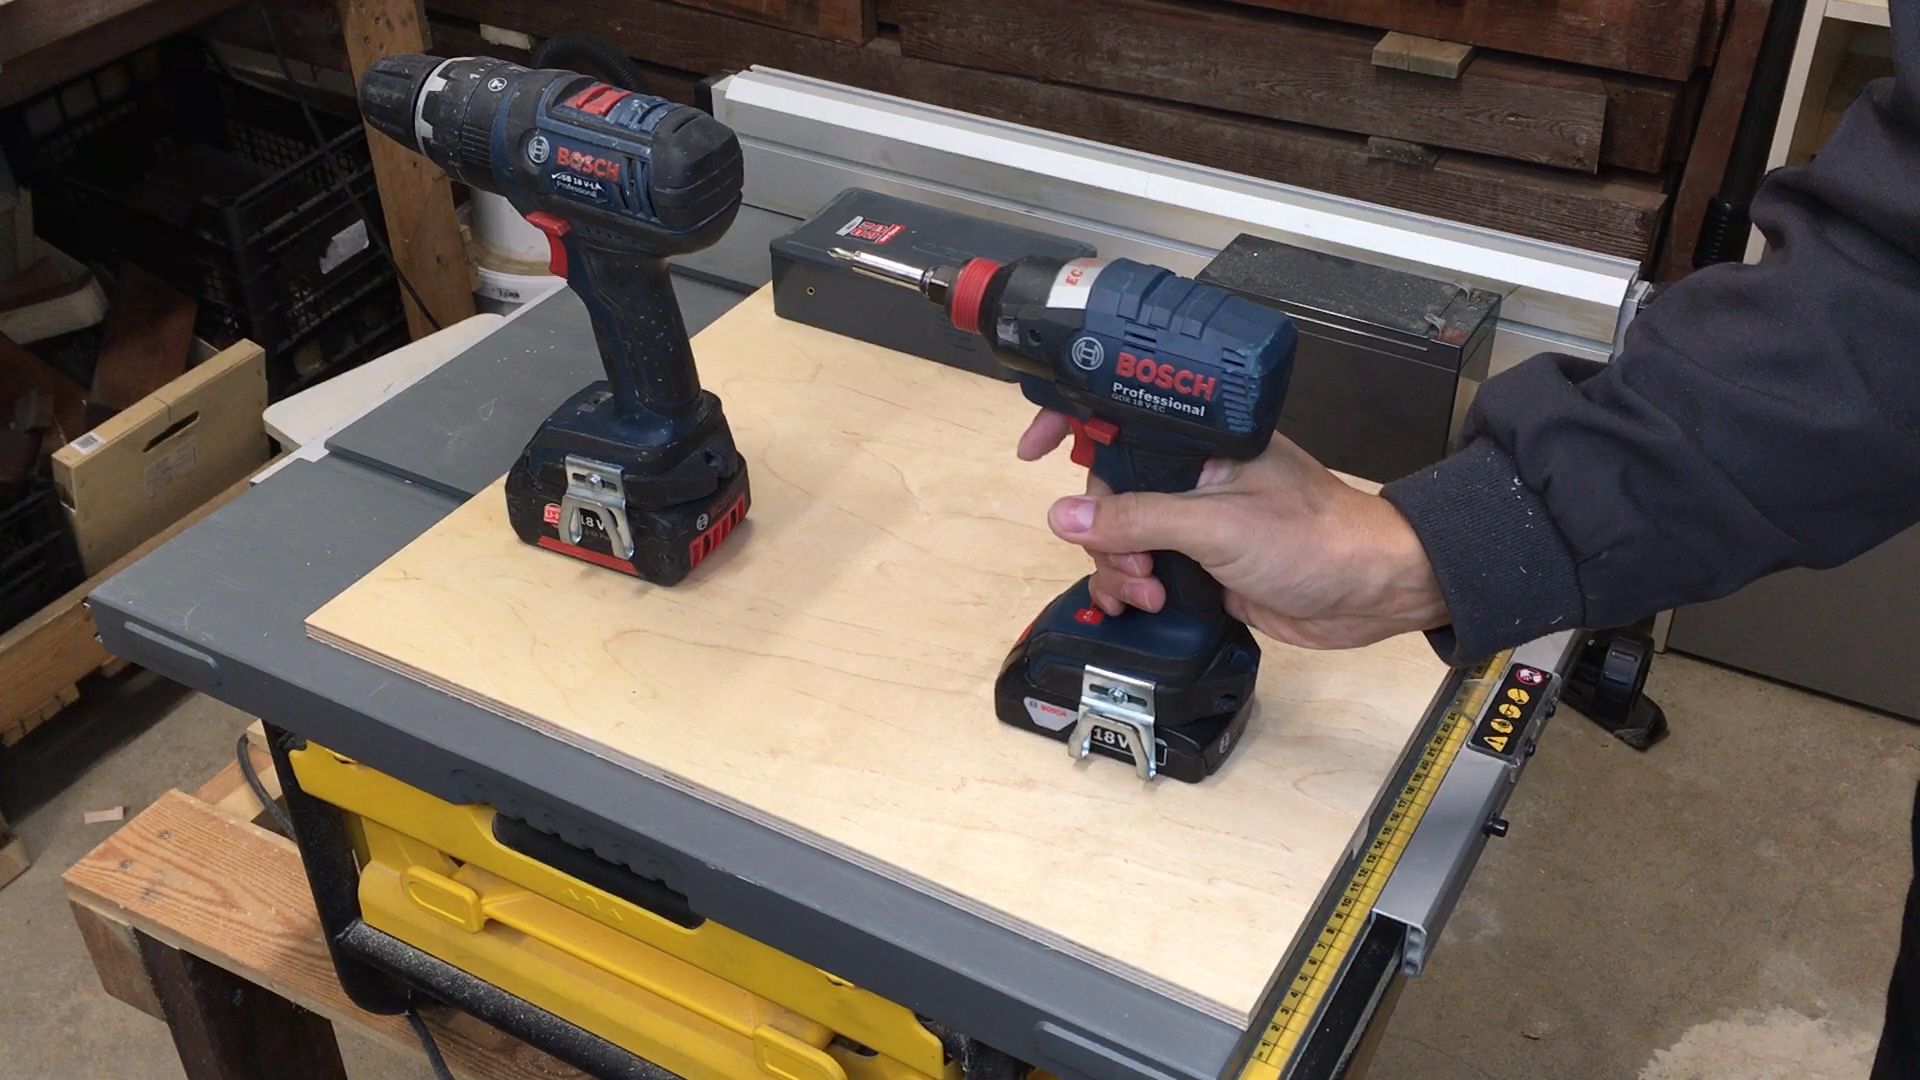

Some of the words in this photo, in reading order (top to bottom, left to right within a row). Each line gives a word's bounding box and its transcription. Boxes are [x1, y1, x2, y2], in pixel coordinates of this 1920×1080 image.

[556, 147, 621, 182] BOSCH
[1116, 352, 1216, 401] BOSCH
[1113, 382, 1206, 417] Professional
[1093, 728, 1128, 749] 18V
[1341, 898, 1352, 907] 10
[1350, 882, 1360, 892] 11
[1358, 869, 1369, 877] 12
[1366, 854, 1377, 864] 13
[1374, 840, 1385, 850] 14
[1382, 827, 1392, 836] 15
[1390, 813, 1400, 822] 16
[1398, 800, 1407, 808] 17
[1405, 787, 1415, 795] 18
[1427, 747, 1437, 758] 21
